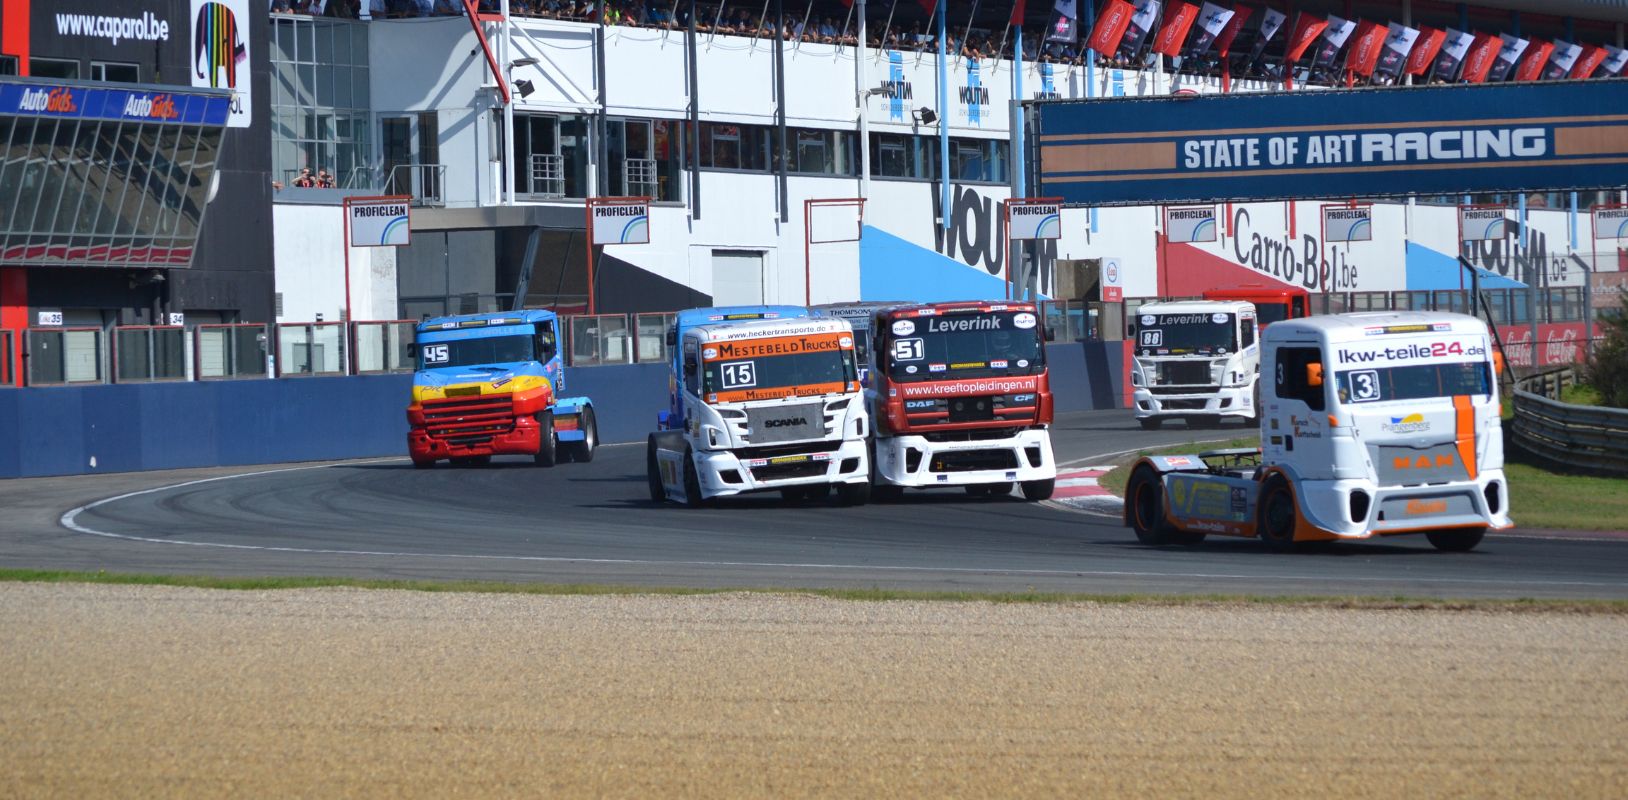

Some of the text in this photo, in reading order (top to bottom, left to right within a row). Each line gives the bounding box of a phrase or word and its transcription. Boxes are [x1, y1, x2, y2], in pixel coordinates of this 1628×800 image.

[57, 11, 169, 46] www.caparol.be
[1184, 128, 1546, 169] STATE OF ART RACING
[354, 206, 406, 218] PROFICLEAN
[595, 206, 644, 217] PROFICLEAN
[1012, 206, 1057, 215] PROFICLEAN
[1170, 210, 1212, 220] PROFICLEAN
[1327, 210, 1368, 219] PROFICLEAN
[1465, 211, 1503, 219] PROFICLEAN
[1234, 207, 1358, 293] Carro-Bel.be
[51, 314, 61, 323] 35
[929, 315, 1001, 333] Leverink
[1159, 314, 1209, 325] Leverink
[1144, 332, 1159, 345] 88
[425, 346, 448, 361] 45
[897, 341, 923, 358] 51
[1338, 341, 1485, 364] lkw-teile24.de
[726, 365, 751, 384] 15
[1276, 363, 1284, 384] 3
[905, 379, 1035, 396] www.kreeftopleidingen.nl
[1357, 374, 1373, 397] 3
[1014, 394, 1035, 402] CF
[764, 417, 807, 428] SCANIA
